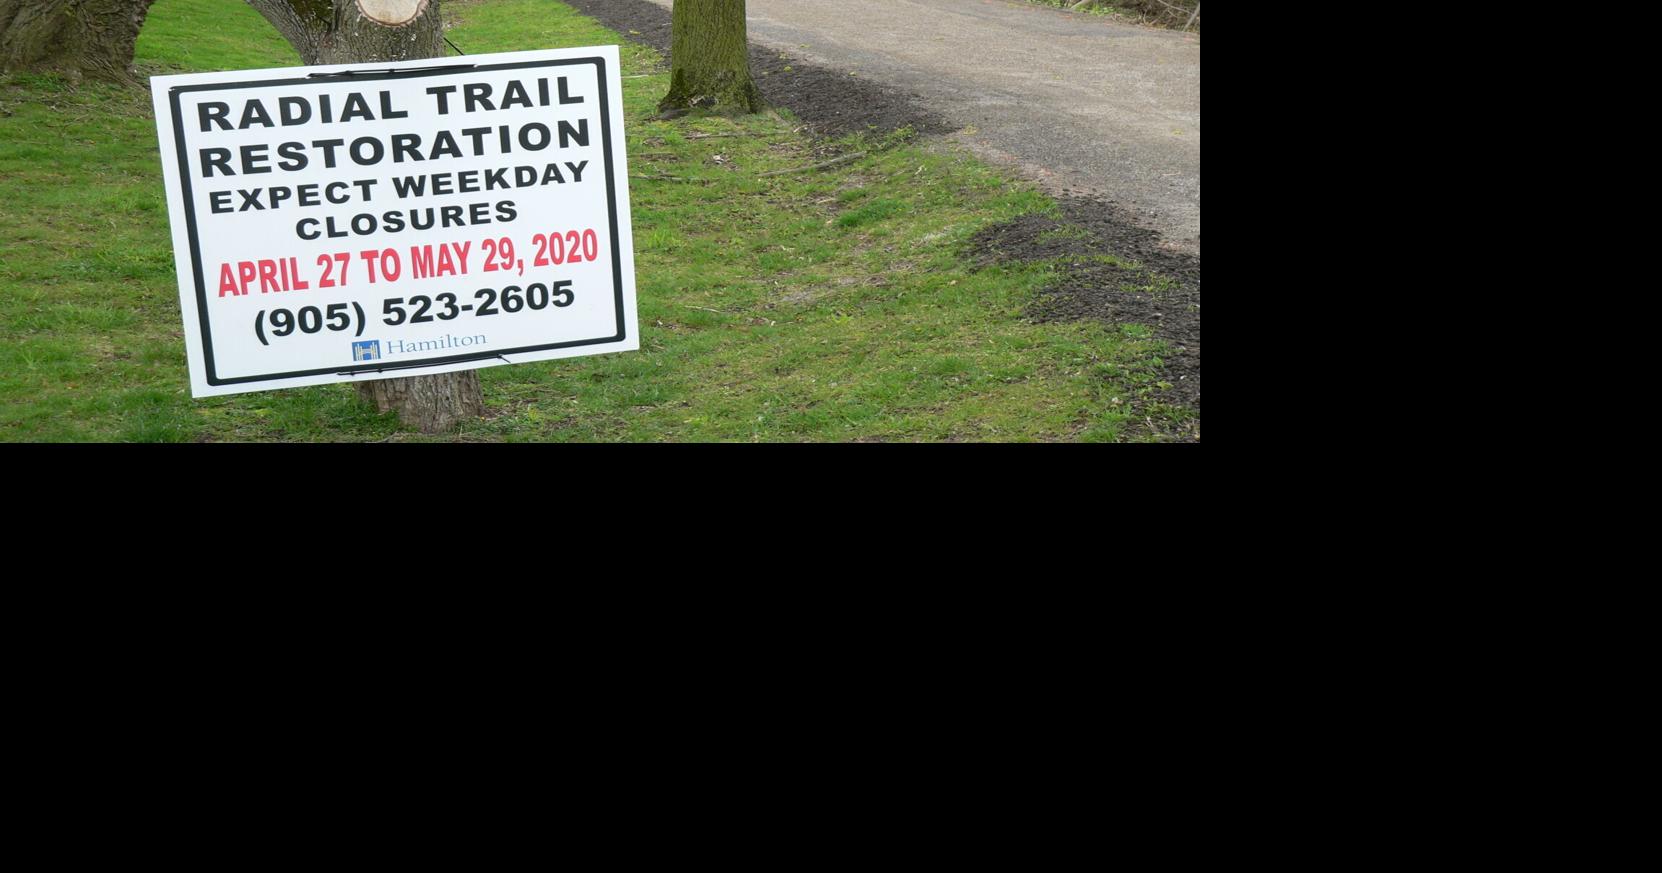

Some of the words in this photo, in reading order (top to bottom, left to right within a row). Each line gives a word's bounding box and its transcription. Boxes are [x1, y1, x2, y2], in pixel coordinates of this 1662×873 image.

[198, 91, 408, 132] RADIAL
[426, 77, 584, 115] TRAIL
[199, 119, 590, 178] RESTORATION
[210, 179, 377, 214] EXPECT
[392, 161, 588, 198] WEEKDAY
[296, 201, 517, 240] CLOSURES
[219, 258, 308, 297] APRIL
[317, 253, 350, 288] 27
[361, 248, 400, 283] TO
[411, 241, 470, 278] MAY
[482, 237, 523, 276] 29,
[533, 229, 597, 266] 2020
[255, 302, 365, 345] (905)
[383, 280, 574, 325] 523-2605
[386, 333, 487, 354] Hamilton
